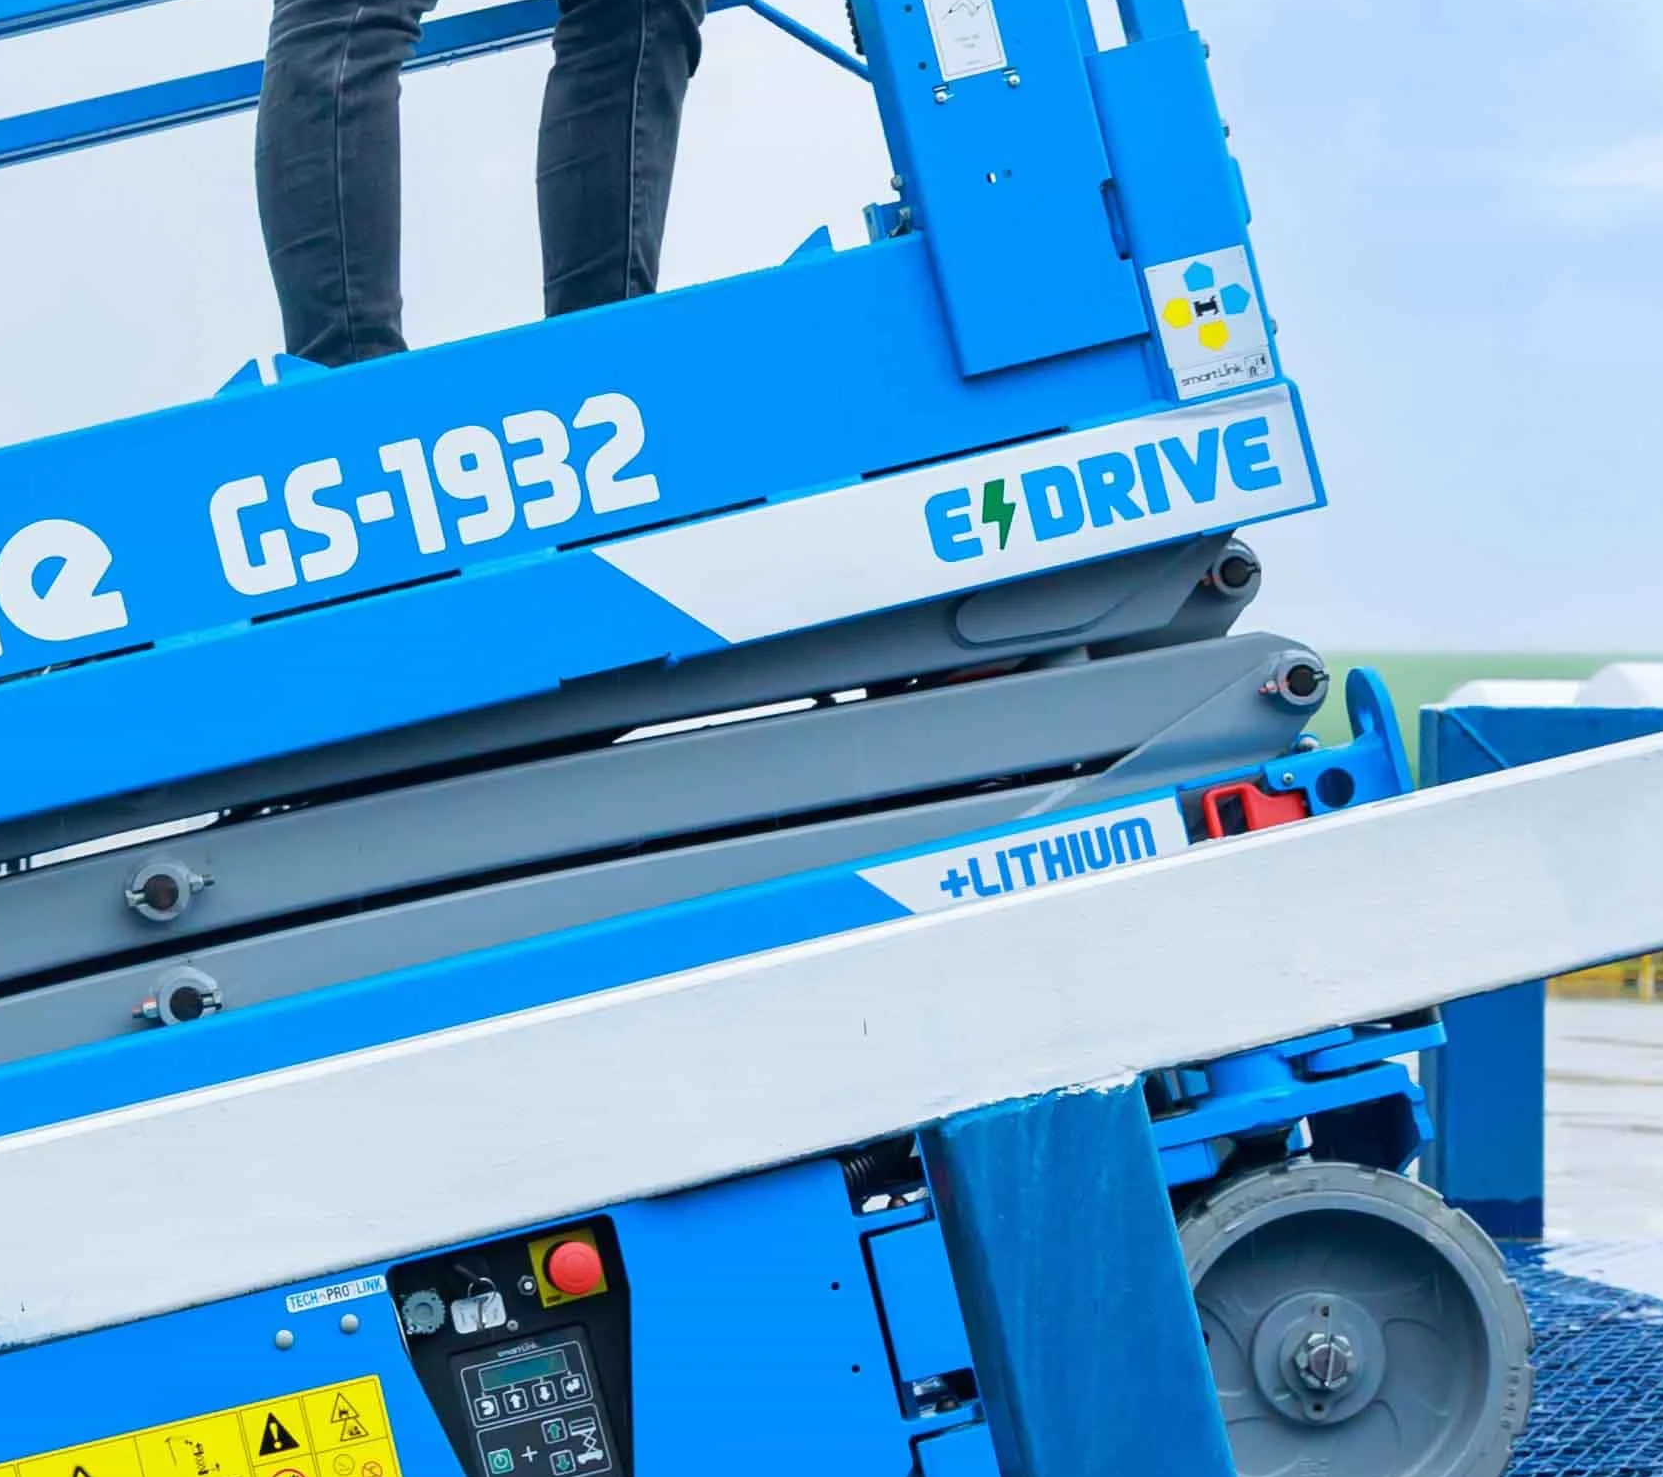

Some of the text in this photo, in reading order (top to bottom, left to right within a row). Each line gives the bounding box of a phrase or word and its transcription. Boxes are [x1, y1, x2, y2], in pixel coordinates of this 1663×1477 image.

[209, 392, 660, 596] GS-1932
[940, 817, 1157, 898] +LITHIUM
[289, 1291, 317, 1310] TECH
[355, 1277, 382, 1294] LINK
